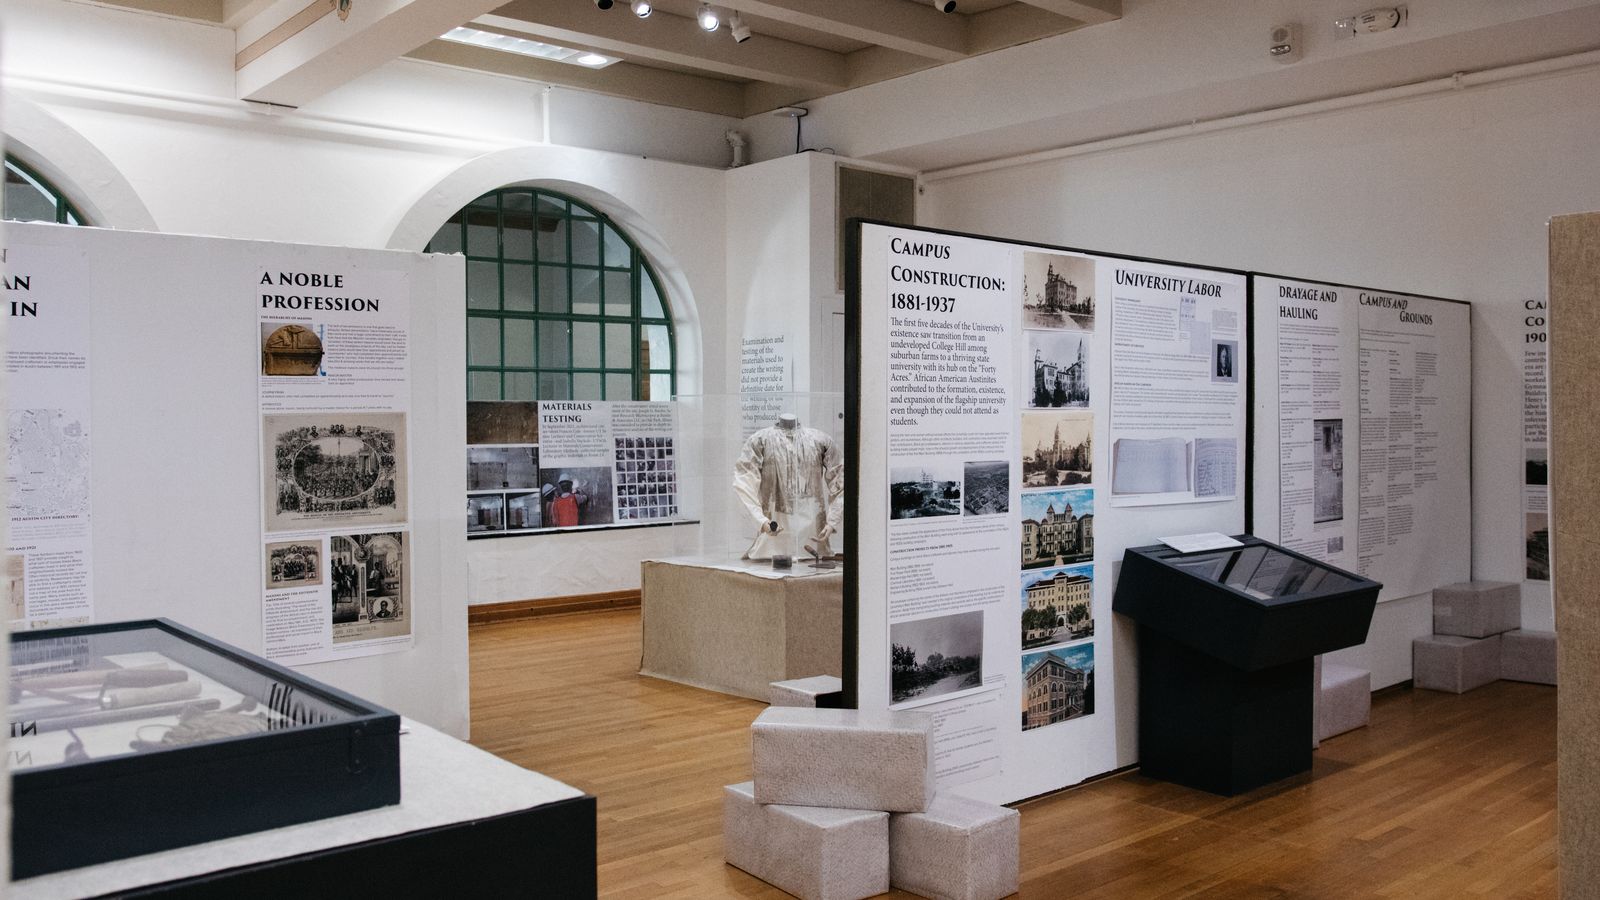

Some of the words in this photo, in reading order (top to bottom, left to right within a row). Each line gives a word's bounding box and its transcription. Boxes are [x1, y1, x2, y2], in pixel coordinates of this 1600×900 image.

[891, 238, 950, 259] CAMPUS
[260, 272, 273, 285] A
[280, 272, 343, 288] NOBLE
[891, 265, 1005, 291] CONSTRUCTION:
[1115, 270, 1186, 292] UNIVERSITY
[1188, 280, 1222, 298] LABOR
[1279, 286, 1318, 300] DRAYAGE
[1320, 290, 1337, 303] AND
[262, 295, 379, 312] PROFESSION
[892, 292, 955, 312] 1881-1937
[1359, 293, 1391, 308] CAMPUS
[1392, 298, 1408, 310] AND
[11, 302, 38, 317] IN
[1279, 306, 1318, 320] HAULING
[891, 317, 902, 326] The
[904, 318, 916, 326] first
[918, 318, 928, 327] five
[930, 320, 952, 329] decades
[954, 321, 960, 329] of
[962, 322, 971, 330] the
[1400, 311, 1432, 325] GROUNDS
[774, 335, 784, 343] and
[890, 330, 918, 338] existence
[933, 331, 961, 340] transition
[963, 332, 976, 341] from
[742, 348, 758, 356] testing
[765, 346, 773, 354] the
[891, 340, 930, 351] undeveloped
[932, 342, 954, 352] College
[956, 343, 966, 351] Hill
[968, 346, 987, 354] among
[891, 350, 919, 359] suburban
[922, 352, 938, 360] farms
[952, 354, 975, 364] thriving
[766, 366, 784, 374] writing
[891, 364, 920, 373] university
[923, 363, 936, 371] with
[968, 364, 977, 372] the
[760, 376, 778, 384] provide
[914, 373, 936, 382] African
[938, 374, 967, 382] American
[969, 375, 996, 383] Austinites
[891, 384, 926, 392] contributed
[936, 385, 945, 393] the
[891, 395, 902, 404] and
[904, 396, 935, 405] expansion
[937, 395, 943, 403] of
[944, 395, 953, 403] the
[955, 395, 977, 406] flagship
[979, 397, 1006, 406] university
[754, 413, 777, 422] produced
[907, 406, 928, 416] though
[930, 406, 943, 416] they
[945, 406, 961, 414] could
[974, 406, 991, 414] attend
[891, 417, 918, 425] students.
